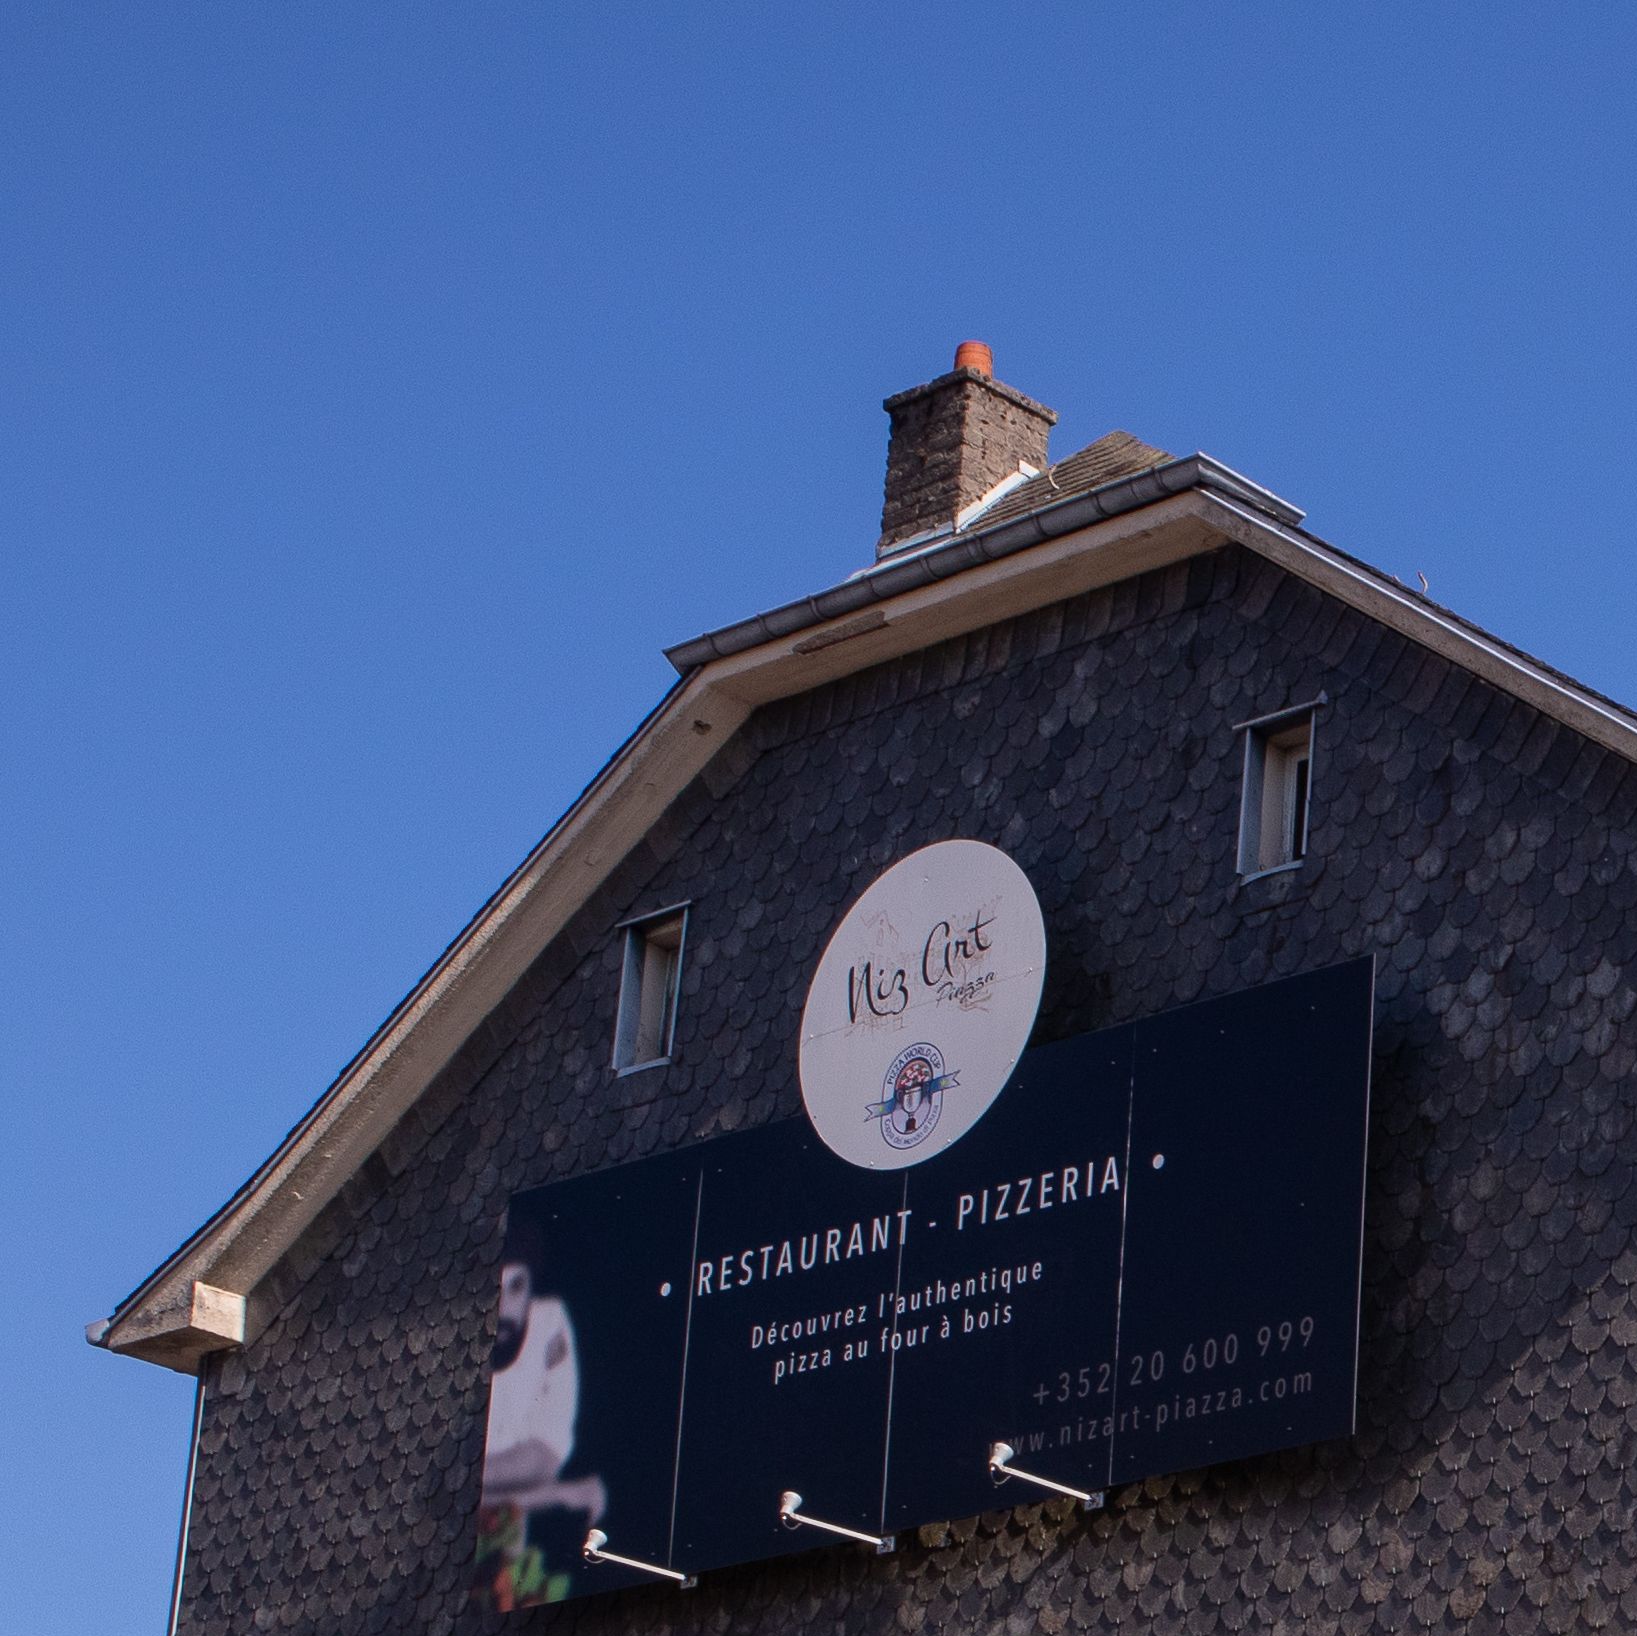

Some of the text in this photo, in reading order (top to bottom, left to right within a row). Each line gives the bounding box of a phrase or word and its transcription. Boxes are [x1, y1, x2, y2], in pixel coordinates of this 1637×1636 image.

[936, 972, 995, 1008] Piazza
[887, 1046, 941, 1085] PIZZA WORLD CUP
[698, 1209, 913, 1296] RESTAURANT
[957, 1156, 1121, 1231] PIZZERIA
[751, 1259, 1044, 1350] Découvrez l'authentique
[774, 1302, 1014, 1385] pizza au four à bois
[1032, 1315, 1315, 1407] +352 20 600 999
[989, 1371, 1314, 1456] ww.nizart-piazza.com
